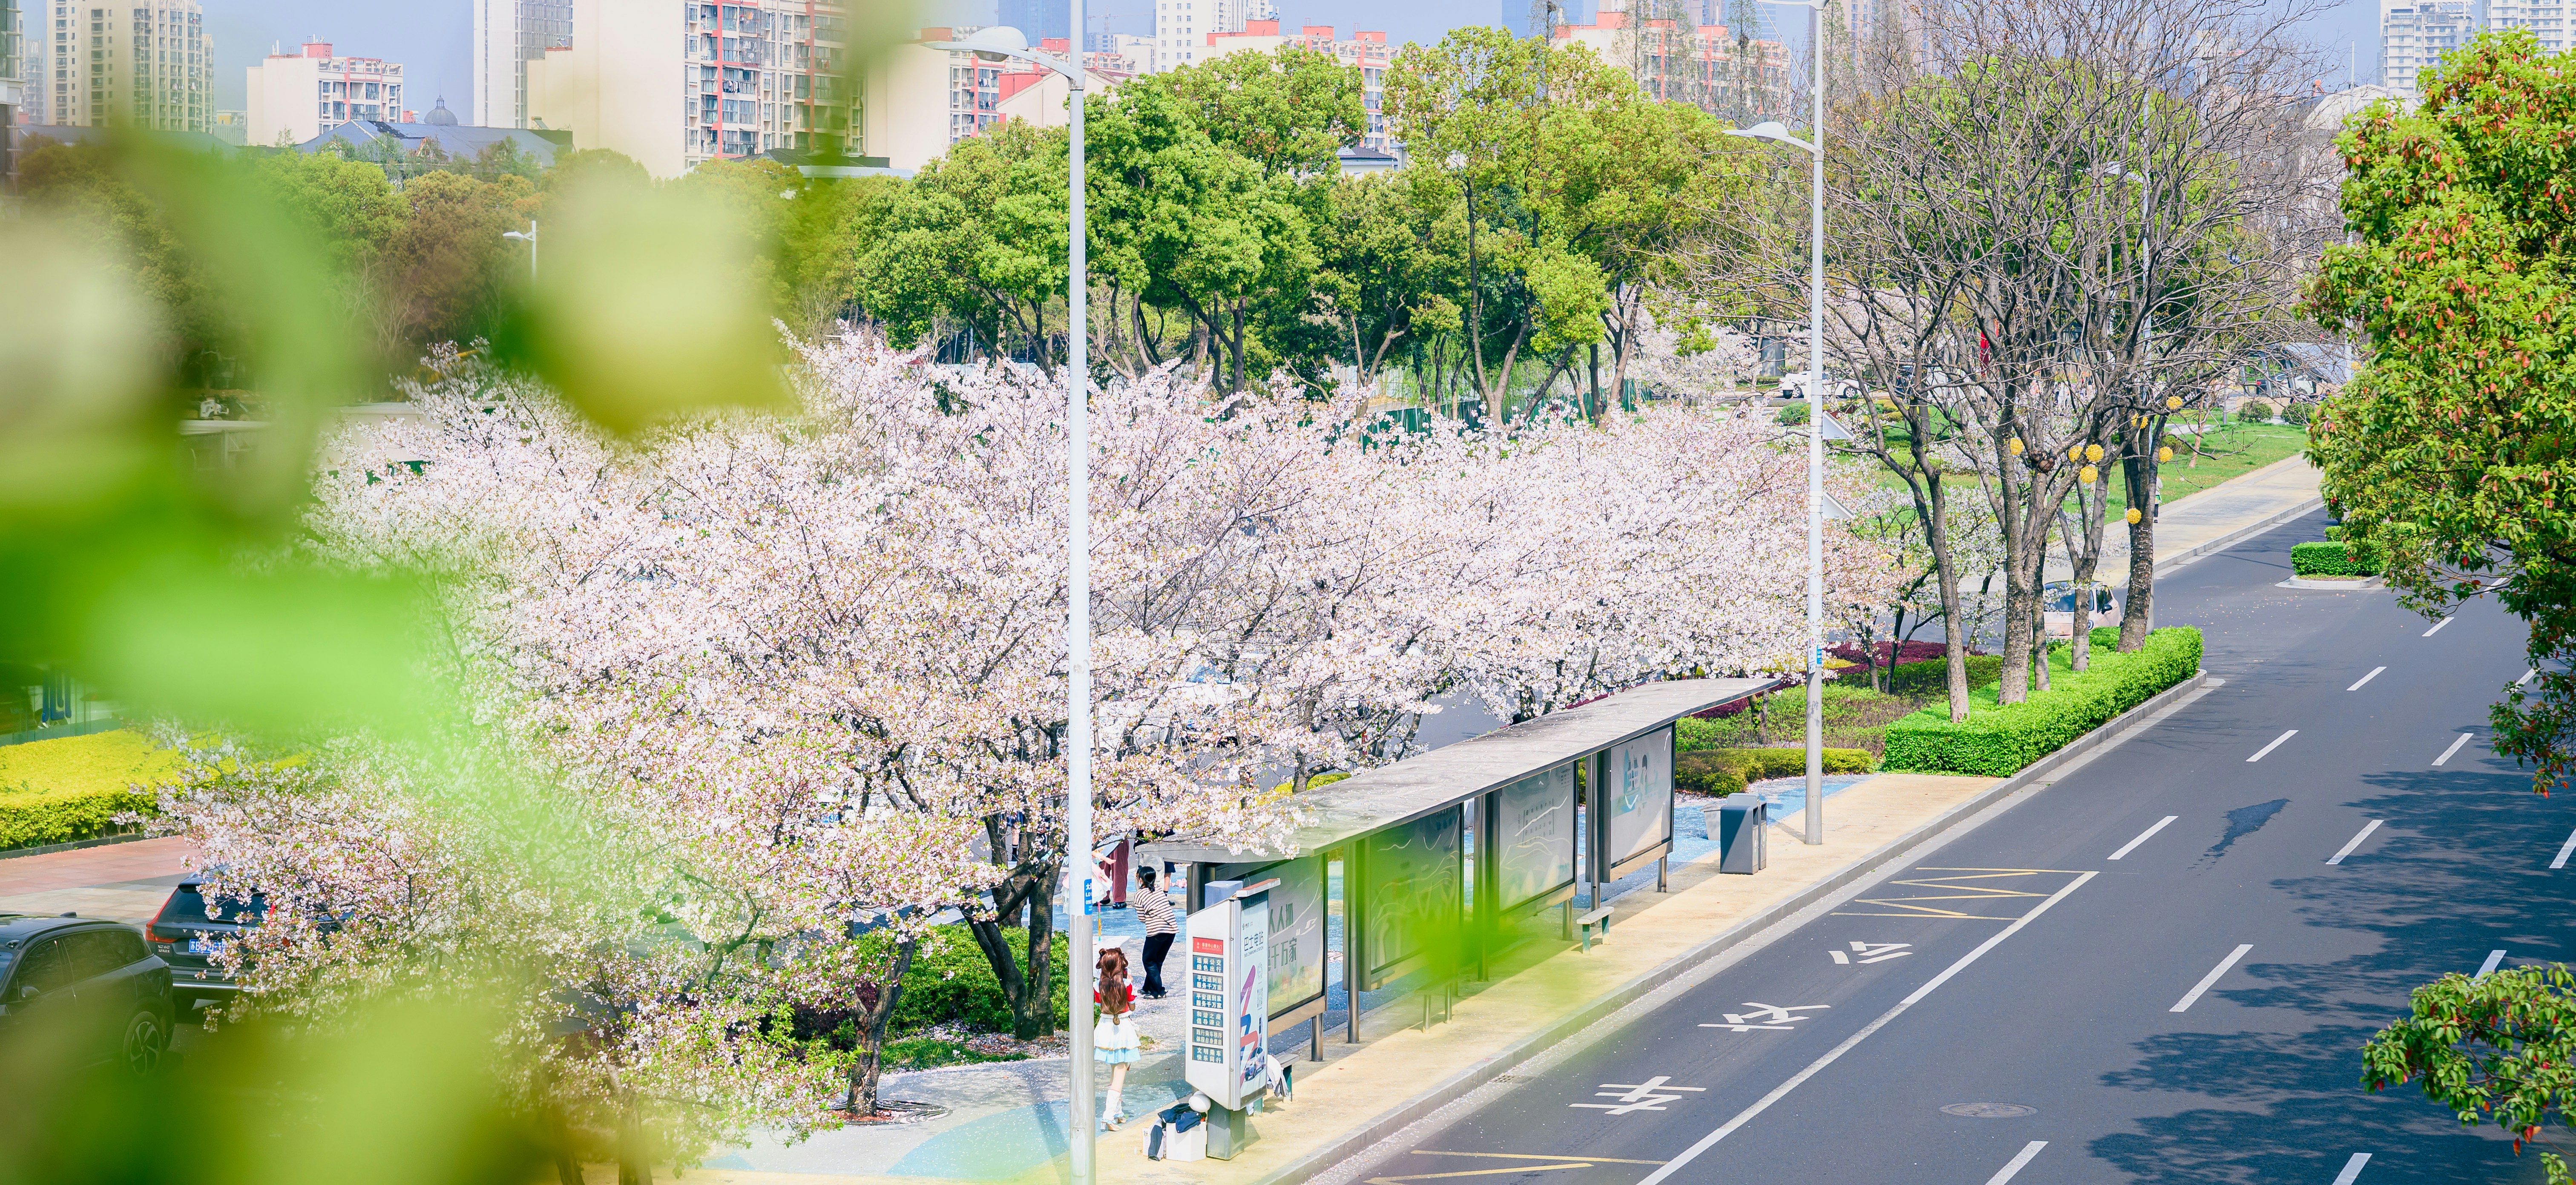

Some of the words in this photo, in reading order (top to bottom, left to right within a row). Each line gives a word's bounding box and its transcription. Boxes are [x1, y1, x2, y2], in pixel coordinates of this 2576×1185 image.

[1244, 930, 1264, 951] 巴士电站
[1197, 964, 1221, 972] 绿色出行
[1197, 975, 1222, 984] 平安送到家
[1197, 981, 1222, 990] 服务千万家
[1196, 993, 1222, 1002] 平安送到家
[1196, 1000, 1222, 1008] 服务千万家
[1197, 1047, 1221, 1056] 文明乘车
[1197, 1054, 1221, 1063] 快乐同行
